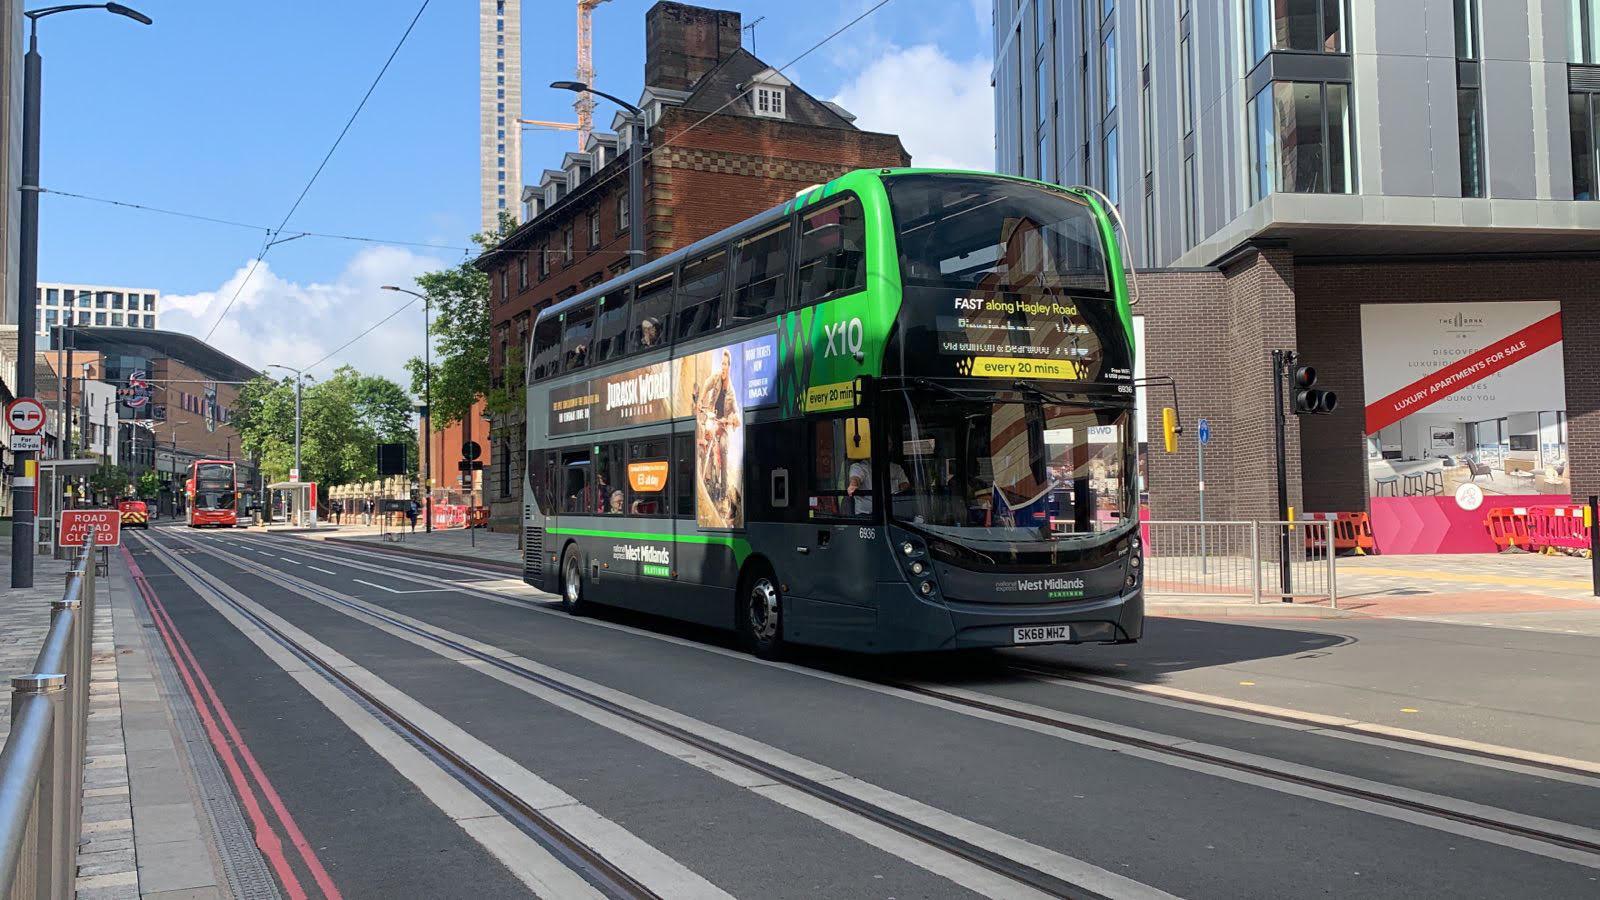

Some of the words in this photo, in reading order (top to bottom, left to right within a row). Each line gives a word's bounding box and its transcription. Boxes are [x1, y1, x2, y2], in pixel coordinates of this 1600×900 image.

[955, 298, 984, 309] FAST
[986, 300, 1014, 314] along
[1016, 301, 1051, 315] Hagley
[1053, 303, 1077, 315] Road
[824, 317, 863, 358] X10
[985, 363, 1016, 375] every
[1018, 363, 1031, 373] 20
[1034, 363, 1059, 374] mins
[1394, 388, 1428, 412] LUXURY
[1429, 360, 1486, 395] APARTMENTS
[1485, 352, 1505, 366] FOR
[1504, 340, 1528, 356] SALE
[748, 386, 768, 399] IMAX
[809, 392, 828, 405] every
[829, 389, 838, 400] 20
[840, 386, 854, 399] min
[1118, 385, 1133, 393] 6936
[74, 514, 107, 522] ROAD
[66, 533, 113, 542] CLOED
[859, 527, 875, 539] 6936
[625, 545, 640, 561] West
[640, 545, 669, 564] Midlands
[1018, 580, 1042, 590] West
[1044, 578, 1084, 590] Midlands
[1018, 628, 1044, 640] SK68
[1047, 627, 1065, 639] MHZ
